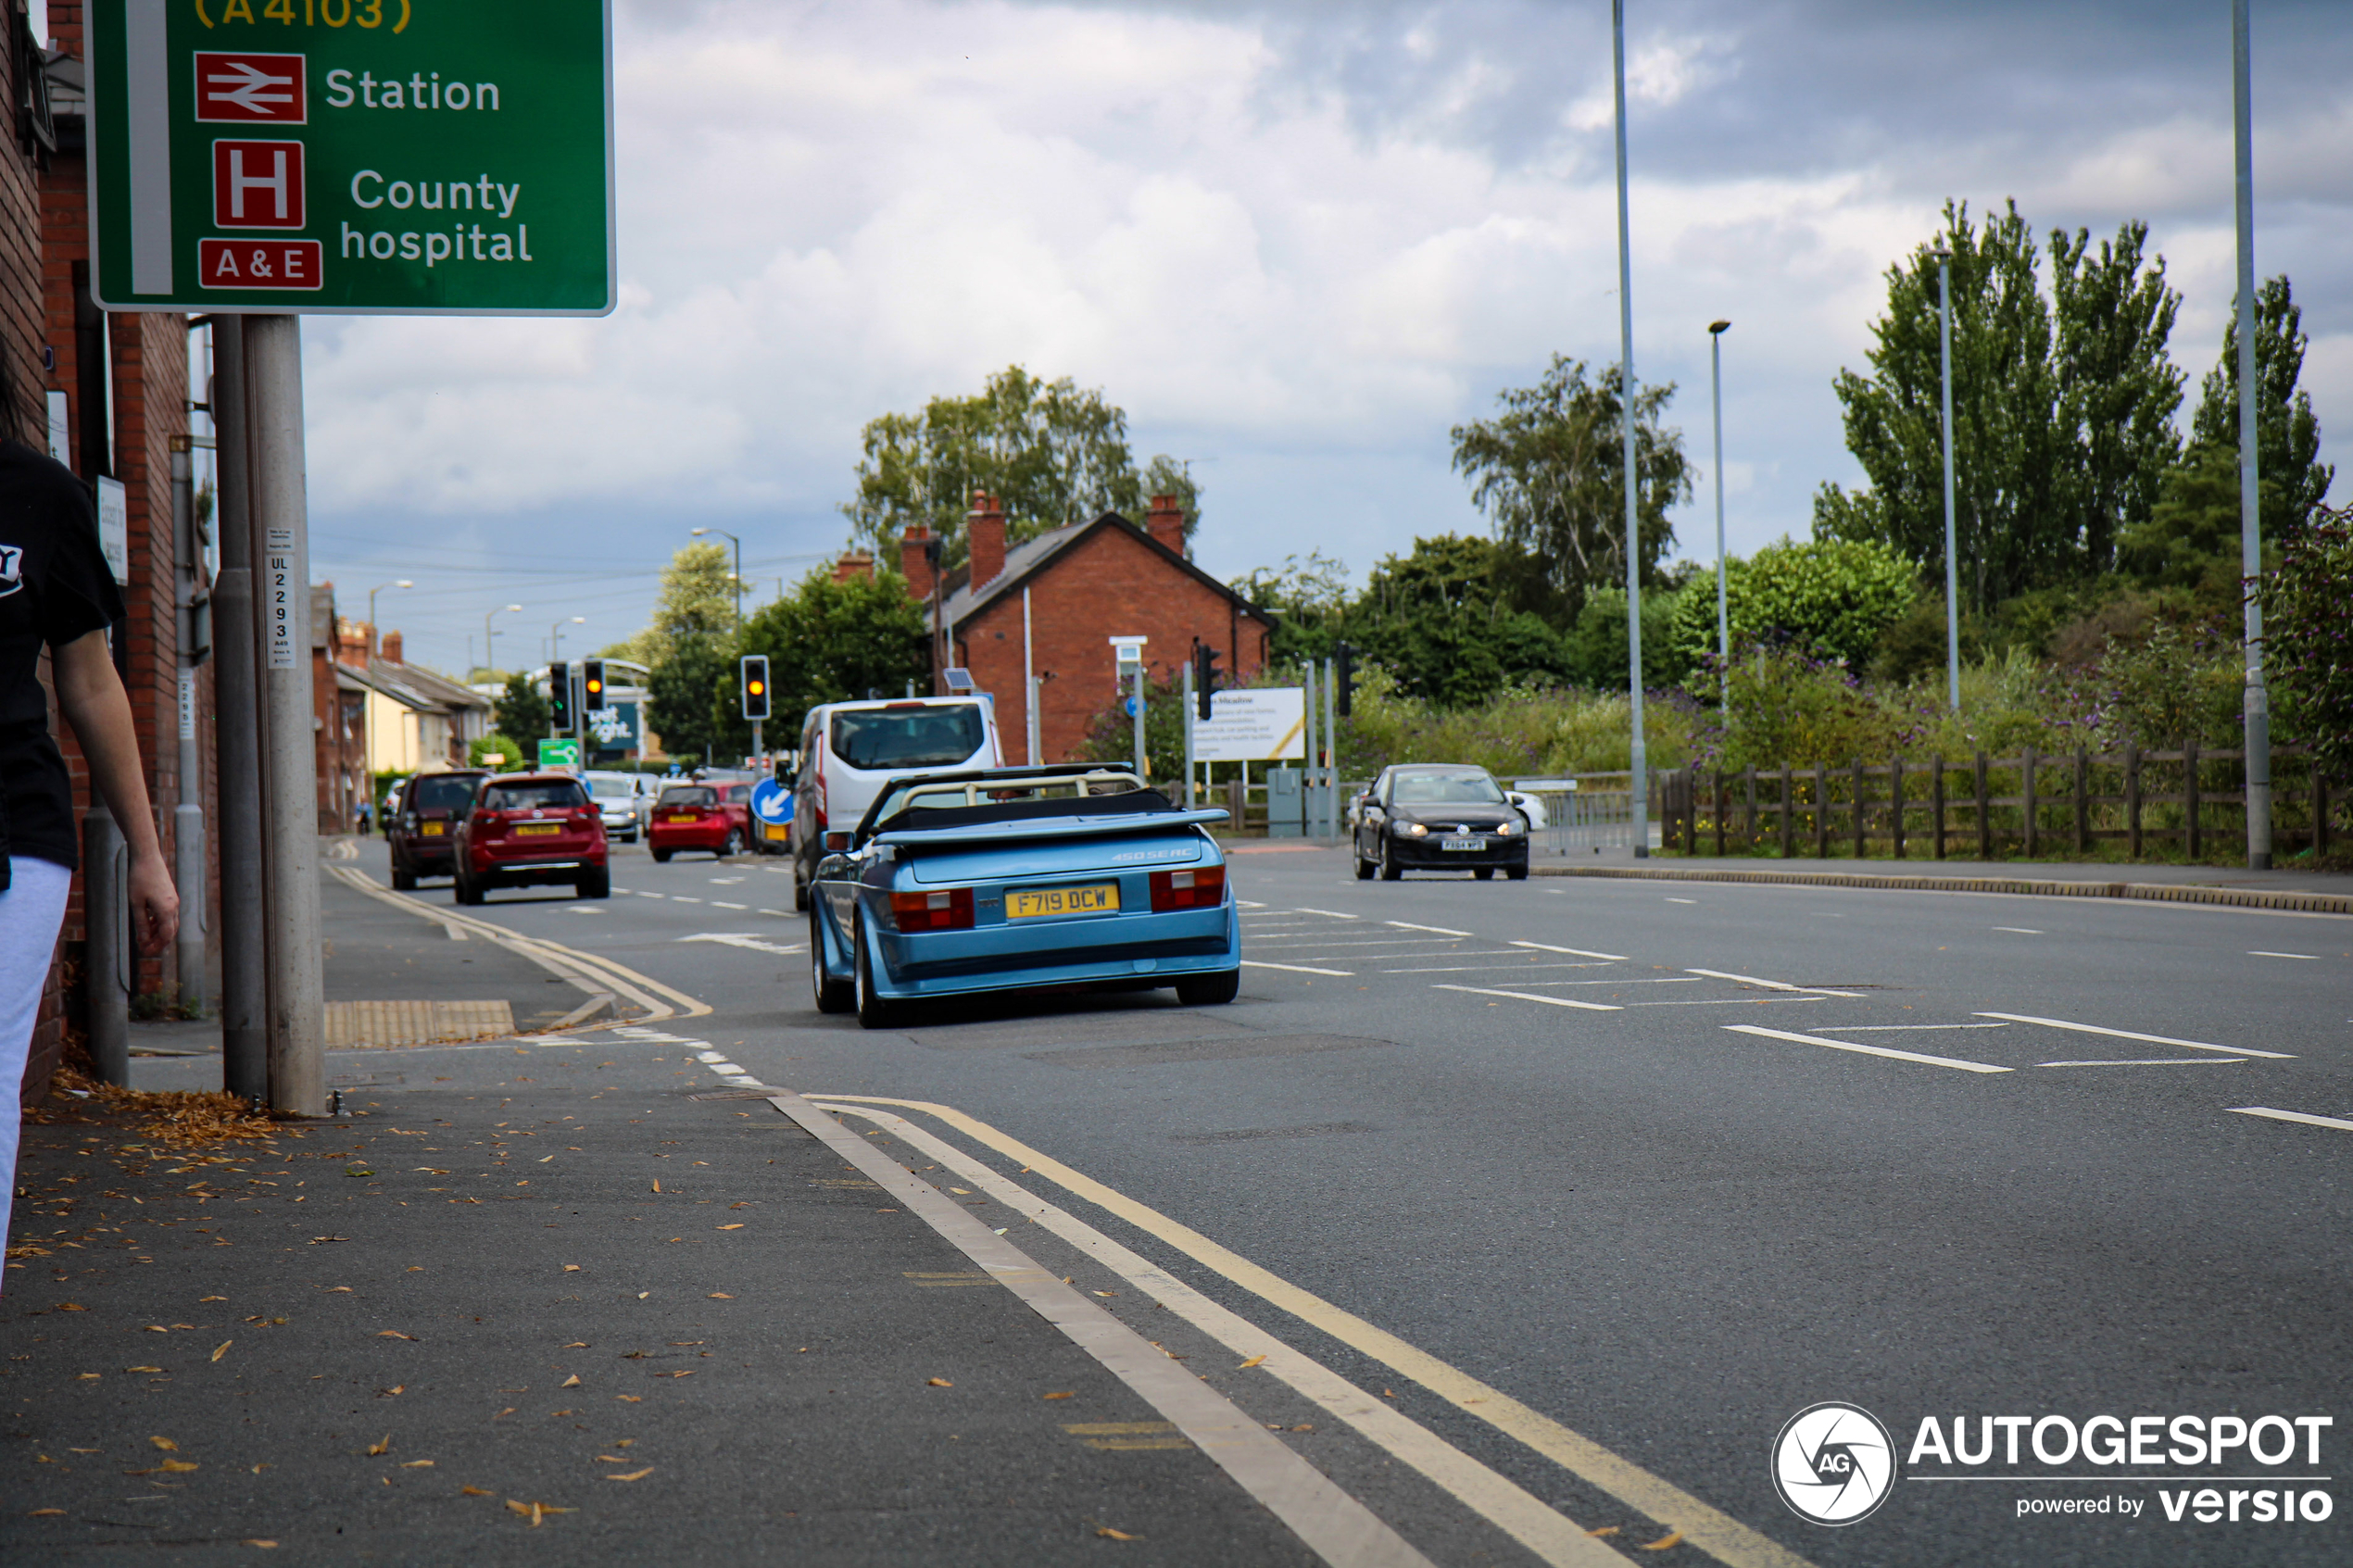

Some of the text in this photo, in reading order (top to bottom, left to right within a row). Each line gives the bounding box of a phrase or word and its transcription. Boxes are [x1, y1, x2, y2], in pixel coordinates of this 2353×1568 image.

[325, 69, 499, 110] Station
[351, 169, 521, 219] County
[341, 221, 533, 267] hospital
[271, 558, 288, 570] UL
[1018, 888, 1106, 914] F719 DCW
